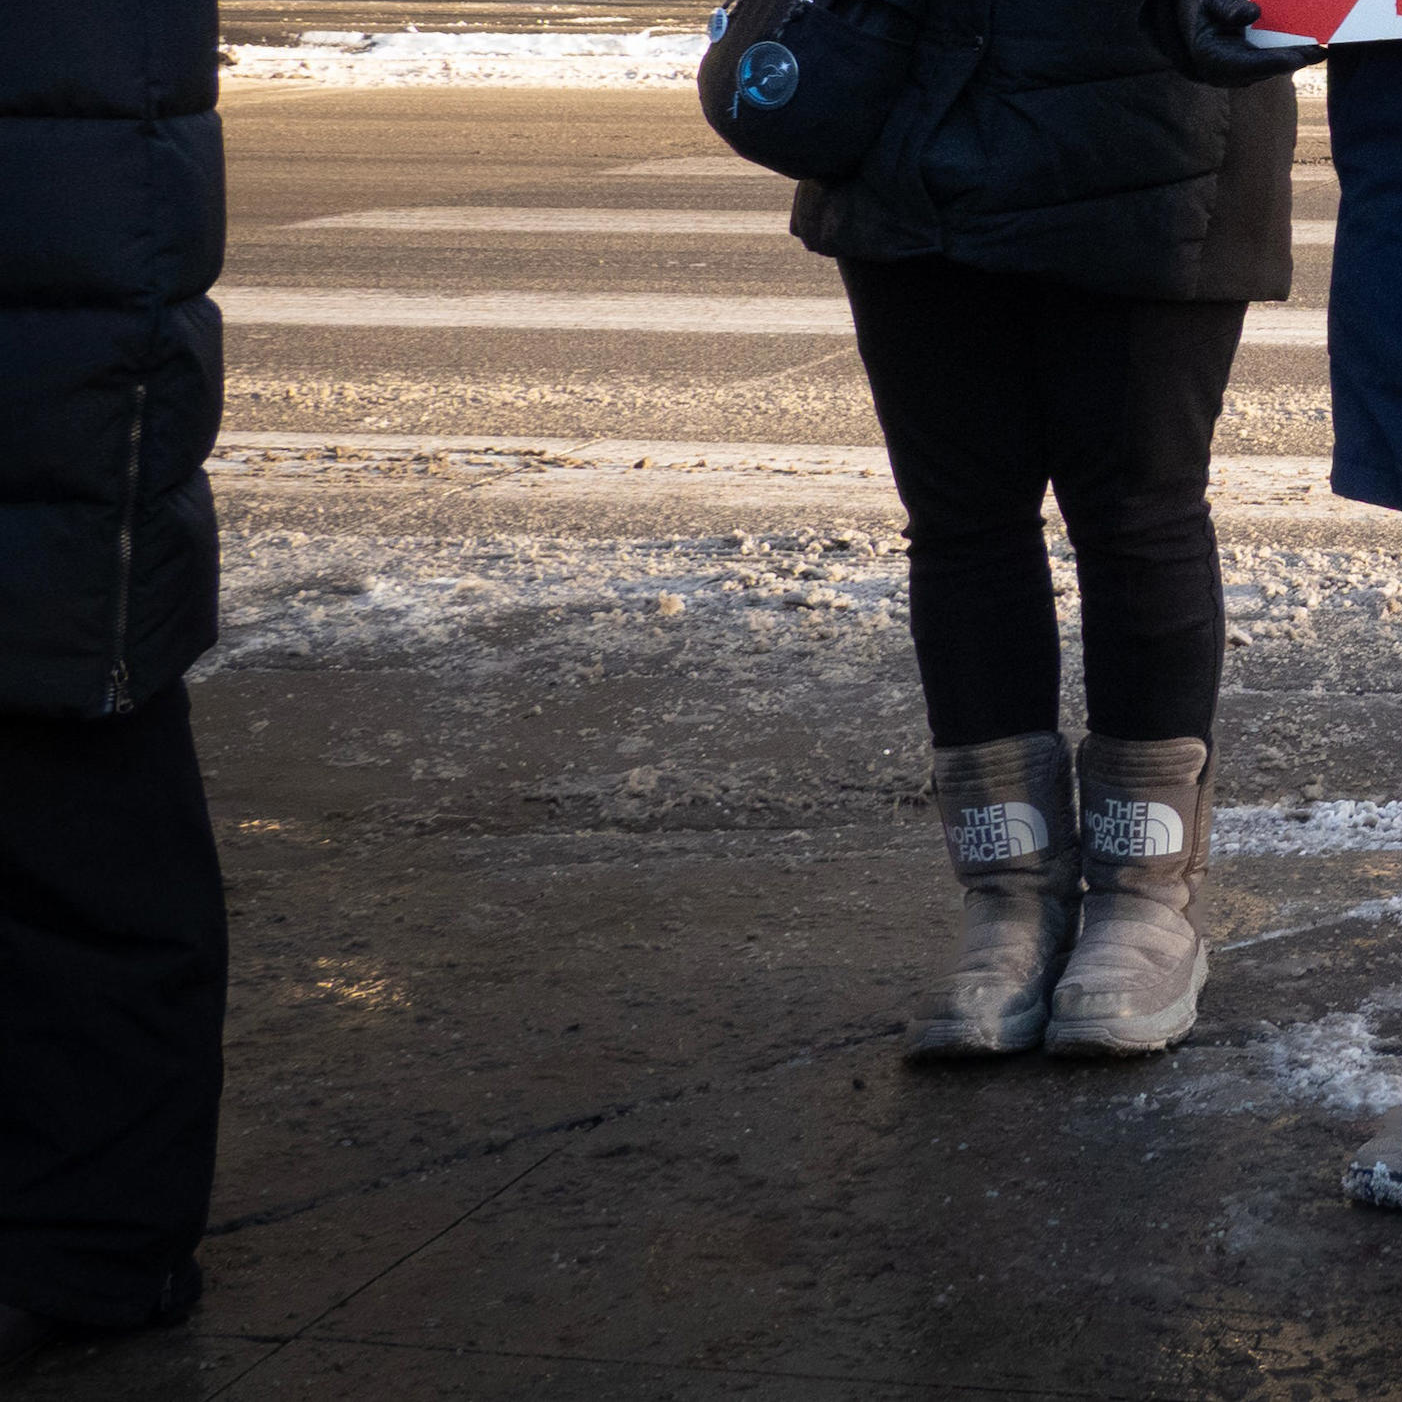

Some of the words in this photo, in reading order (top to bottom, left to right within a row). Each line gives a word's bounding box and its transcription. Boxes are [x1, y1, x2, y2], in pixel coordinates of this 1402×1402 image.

[961, 804, 1003, 826] THE
[1104, 798, 1148, 821] THE
[950, 824, 1008, 845] NORTH
[1085, 810, 1145, 839] NORTH
[958, 839, 1010, 863] FACE
[1094, 835, 1145, 856] FACE
